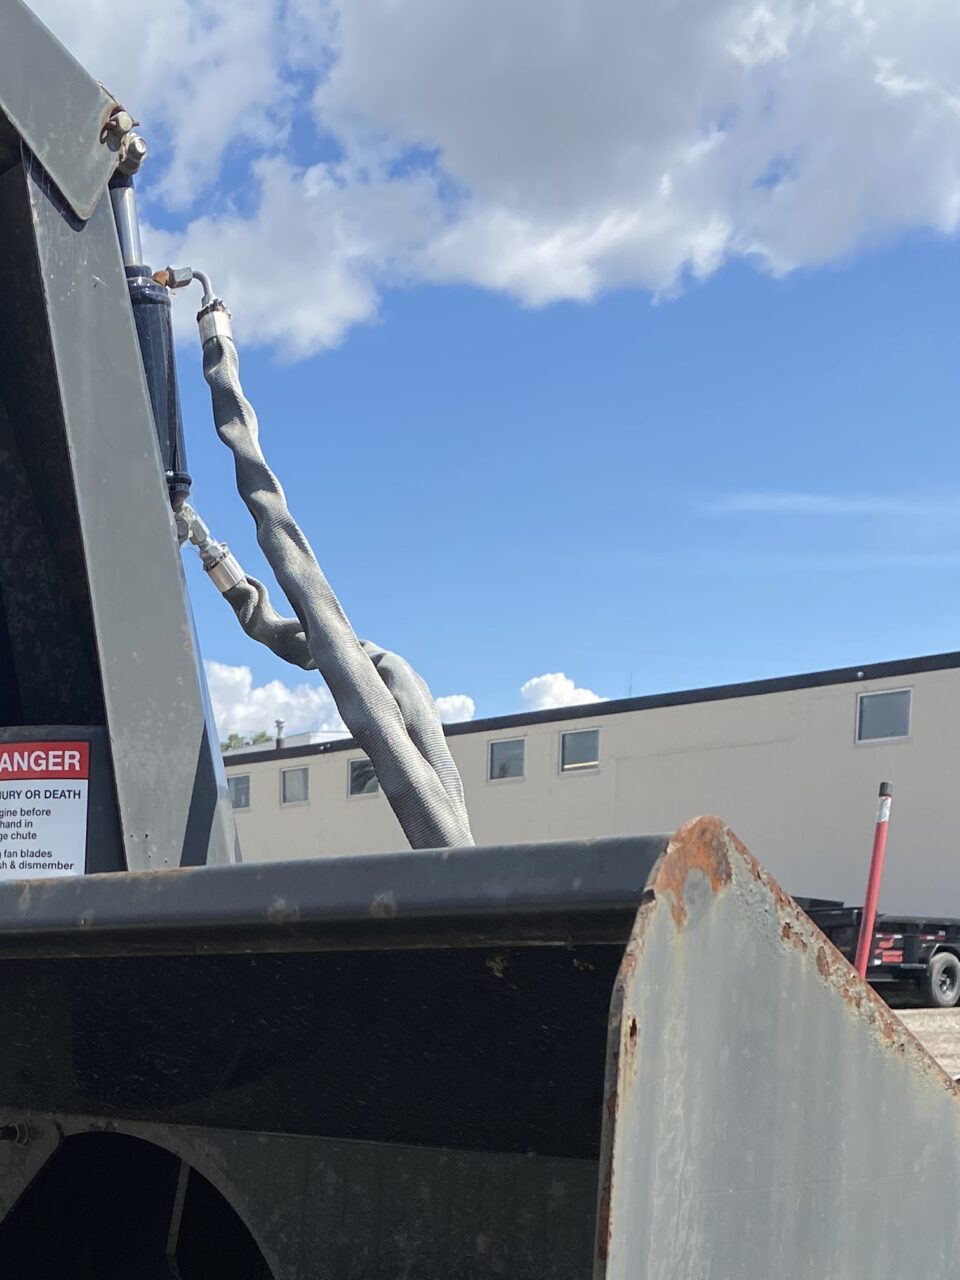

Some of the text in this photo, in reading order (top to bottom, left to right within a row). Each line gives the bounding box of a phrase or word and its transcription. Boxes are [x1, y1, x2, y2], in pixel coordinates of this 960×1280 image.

[25, 790, 41, 799] OR
[44, 789, 81, 800] DEATH
[20, 807, 52, 817] before
[0, 819, 22, 829] hand
[25, 819, 33, 828] in
[10, 831, 37, 840] chute
[4, 849, 18, 858] fan
[20, 849, 52, 858] blades
[9, 861, 16, 870] &
[18, 861, 74, 870] dismember
